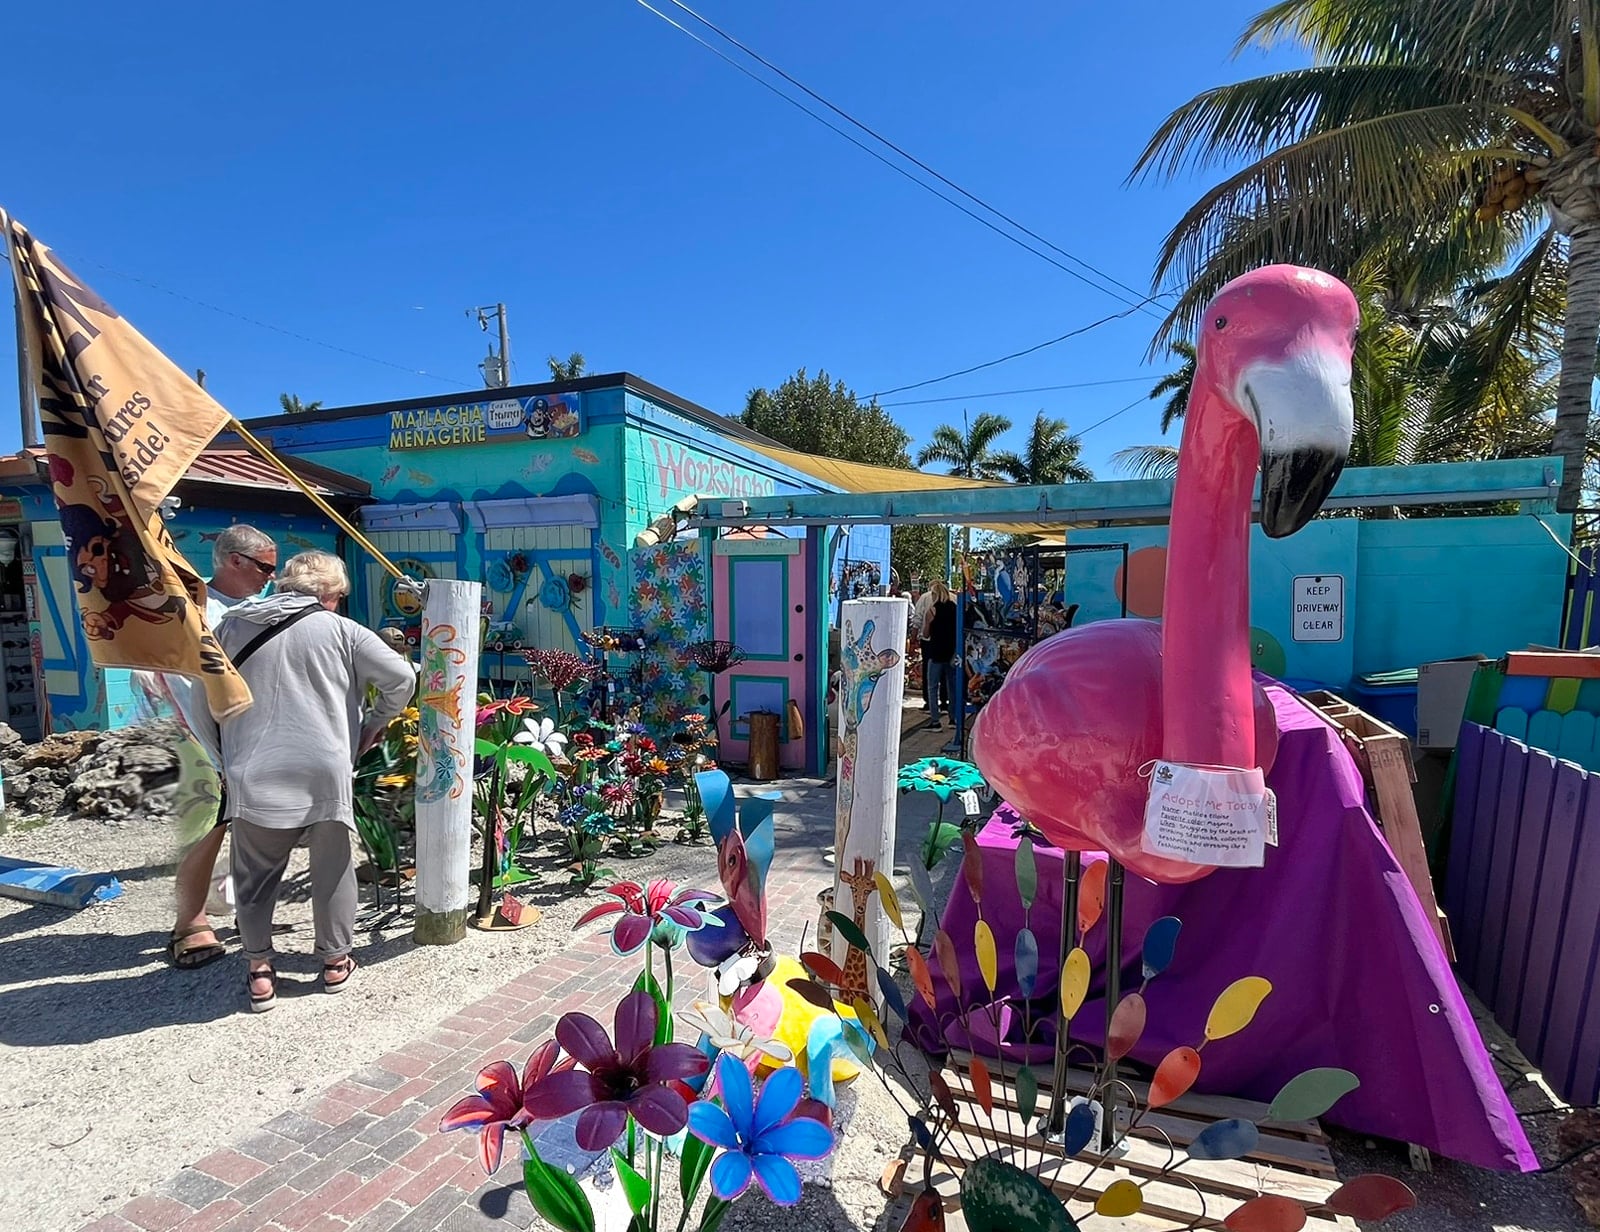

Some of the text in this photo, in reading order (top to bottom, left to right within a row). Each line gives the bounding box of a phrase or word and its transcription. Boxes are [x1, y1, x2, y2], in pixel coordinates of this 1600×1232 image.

[391, 405, 484, 430] MATLACHA
[389, 424, 486, 449] MENAGERIE
[121, 421, 170, 486] side!
[1306, 586, 1331, 596] KEEP
[1296, 603, 1339, 613] DRIVEWAY
[1302, 620, 1333, 630] CLEAR
[1160, 792, 1258, 814] Adopt Me Today
[1220, 836, 1248, 844] collecting
